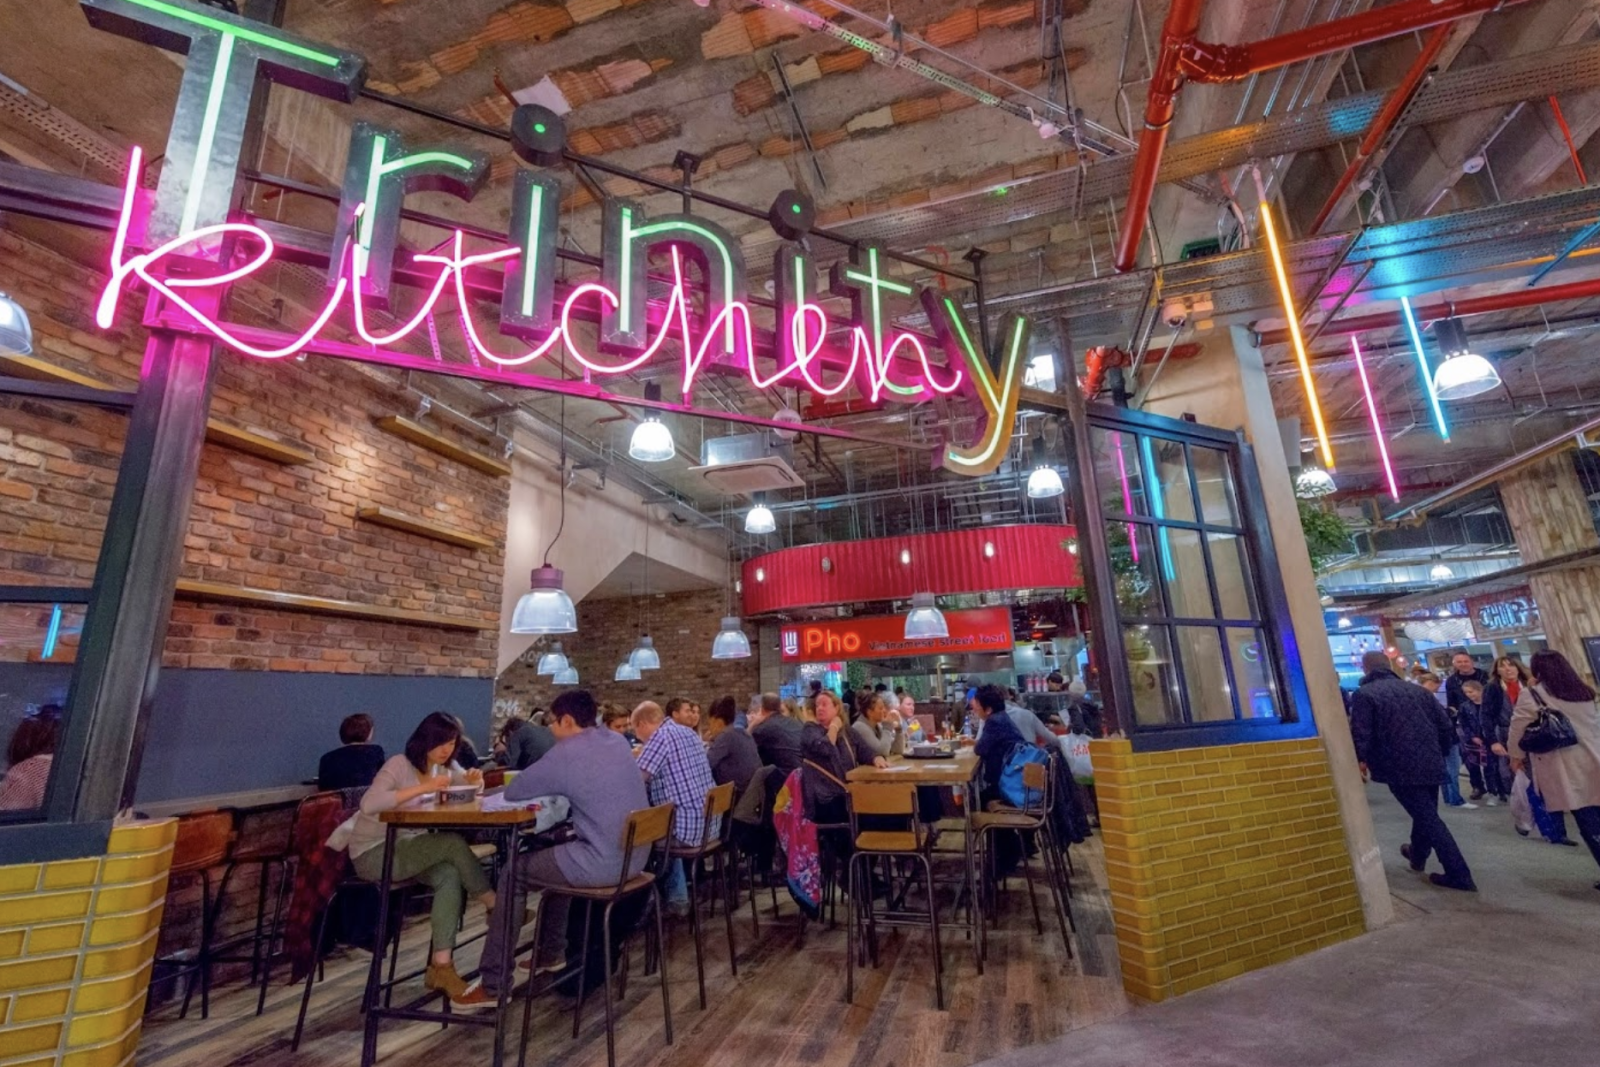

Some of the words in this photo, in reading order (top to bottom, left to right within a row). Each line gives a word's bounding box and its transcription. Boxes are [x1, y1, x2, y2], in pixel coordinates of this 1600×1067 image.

[77, 0, 1032, 476] Trinity
[804, 628, 861, 654] Pho
[868, 638, 935, 651] Vietnamese
[939, 635, 975, 647] street
[978, 631, 1007, 644] food
[447, 792, 466, 803] Pho
